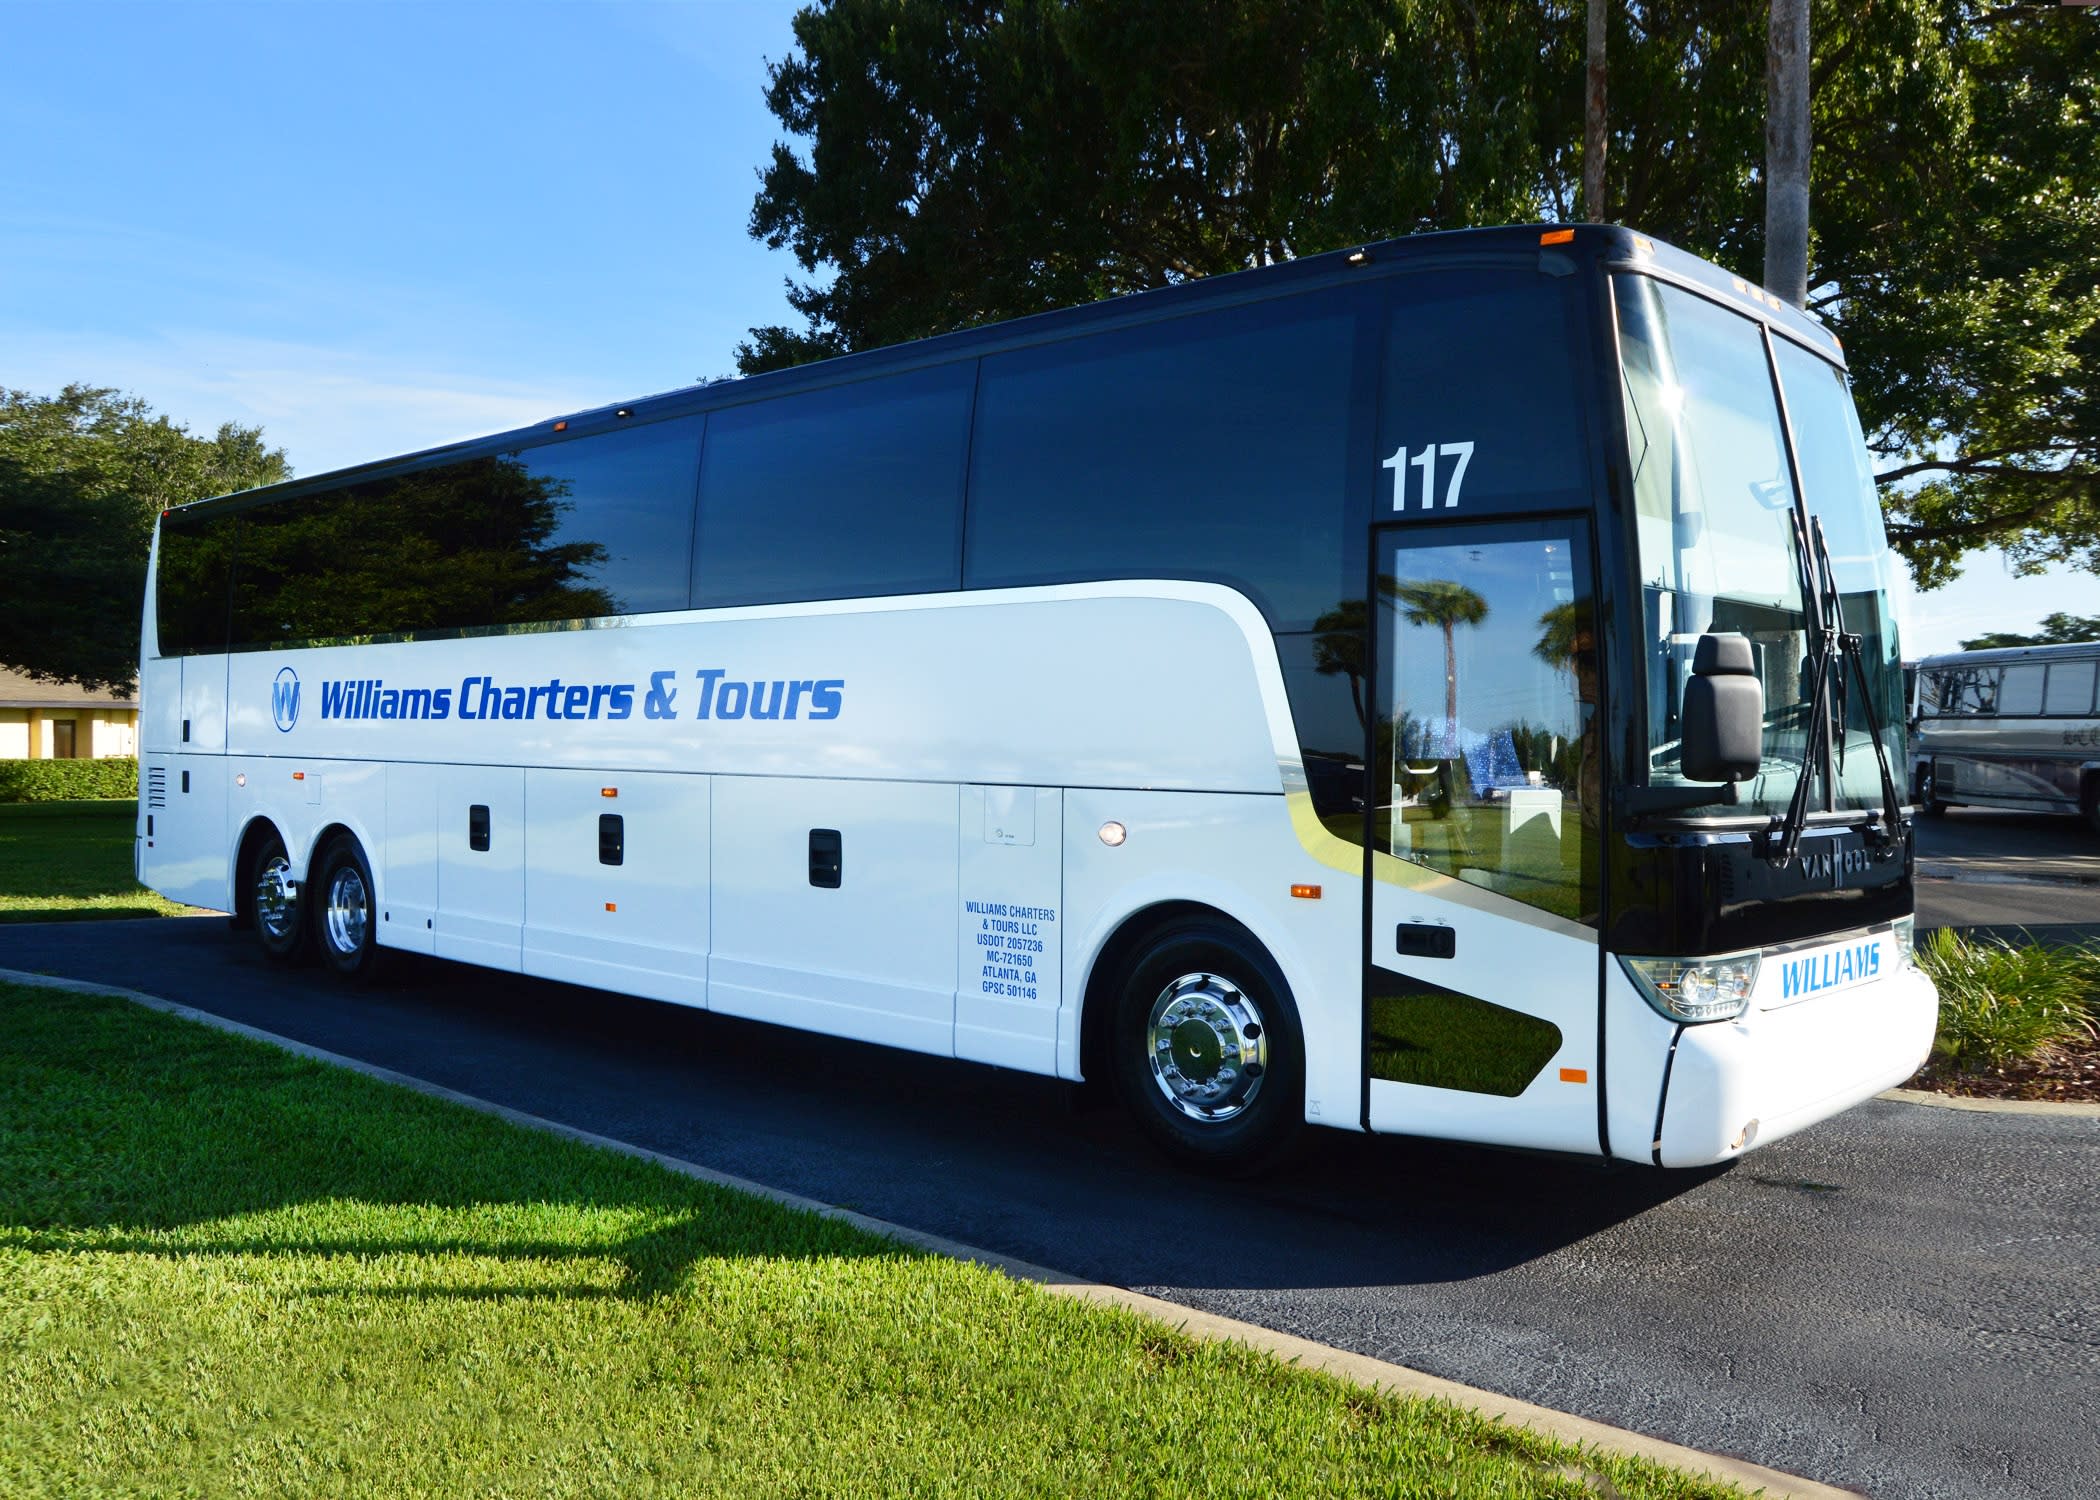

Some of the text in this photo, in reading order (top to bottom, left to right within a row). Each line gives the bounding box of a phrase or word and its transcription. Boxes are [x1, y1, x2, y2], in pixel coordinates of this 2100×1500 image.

[1382, 441, 1475, 512] 117
[321, 668, 845, 721] Williams Charters & Tours
[966, 901, 1055, 922] WILLIAMS CHARTERS
[982, 918, 1038, 936] & TOURS LLC
[977, 933, 1043, 953] USDOT 2057236
[986, 950, 1033, 967] MC-721650
[1024, 971, 1037, 984] GA
[1782, 942, 1881, 999] WILLIAMS
[982, 980, 1037, 1000] GPSC 501146
